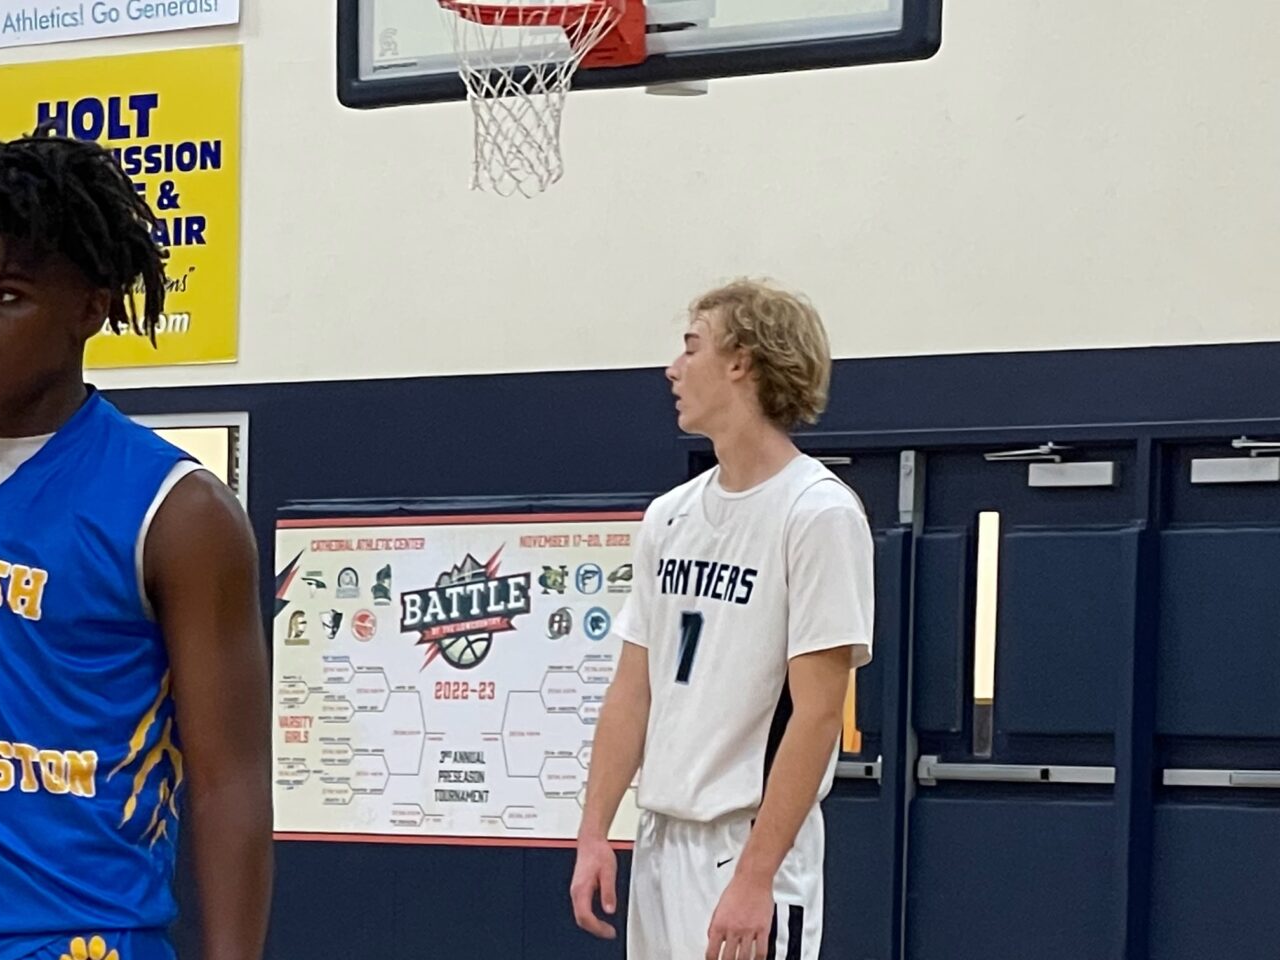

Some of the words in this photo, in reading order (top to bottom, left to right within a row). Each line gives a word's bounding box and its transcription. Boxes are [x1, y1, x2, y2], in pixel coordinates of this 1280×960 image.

[2, 4, 84, 35] Athletics!
[92, 1, 120, 25] Go
[37, 93, 158, 141] HOLT
[156, 180, 181, 210] &
[152, 216, 206, 247] AIR
[402, 575, 526, 626] BATTLE
[434, 681, 496, 700] 2022-23
